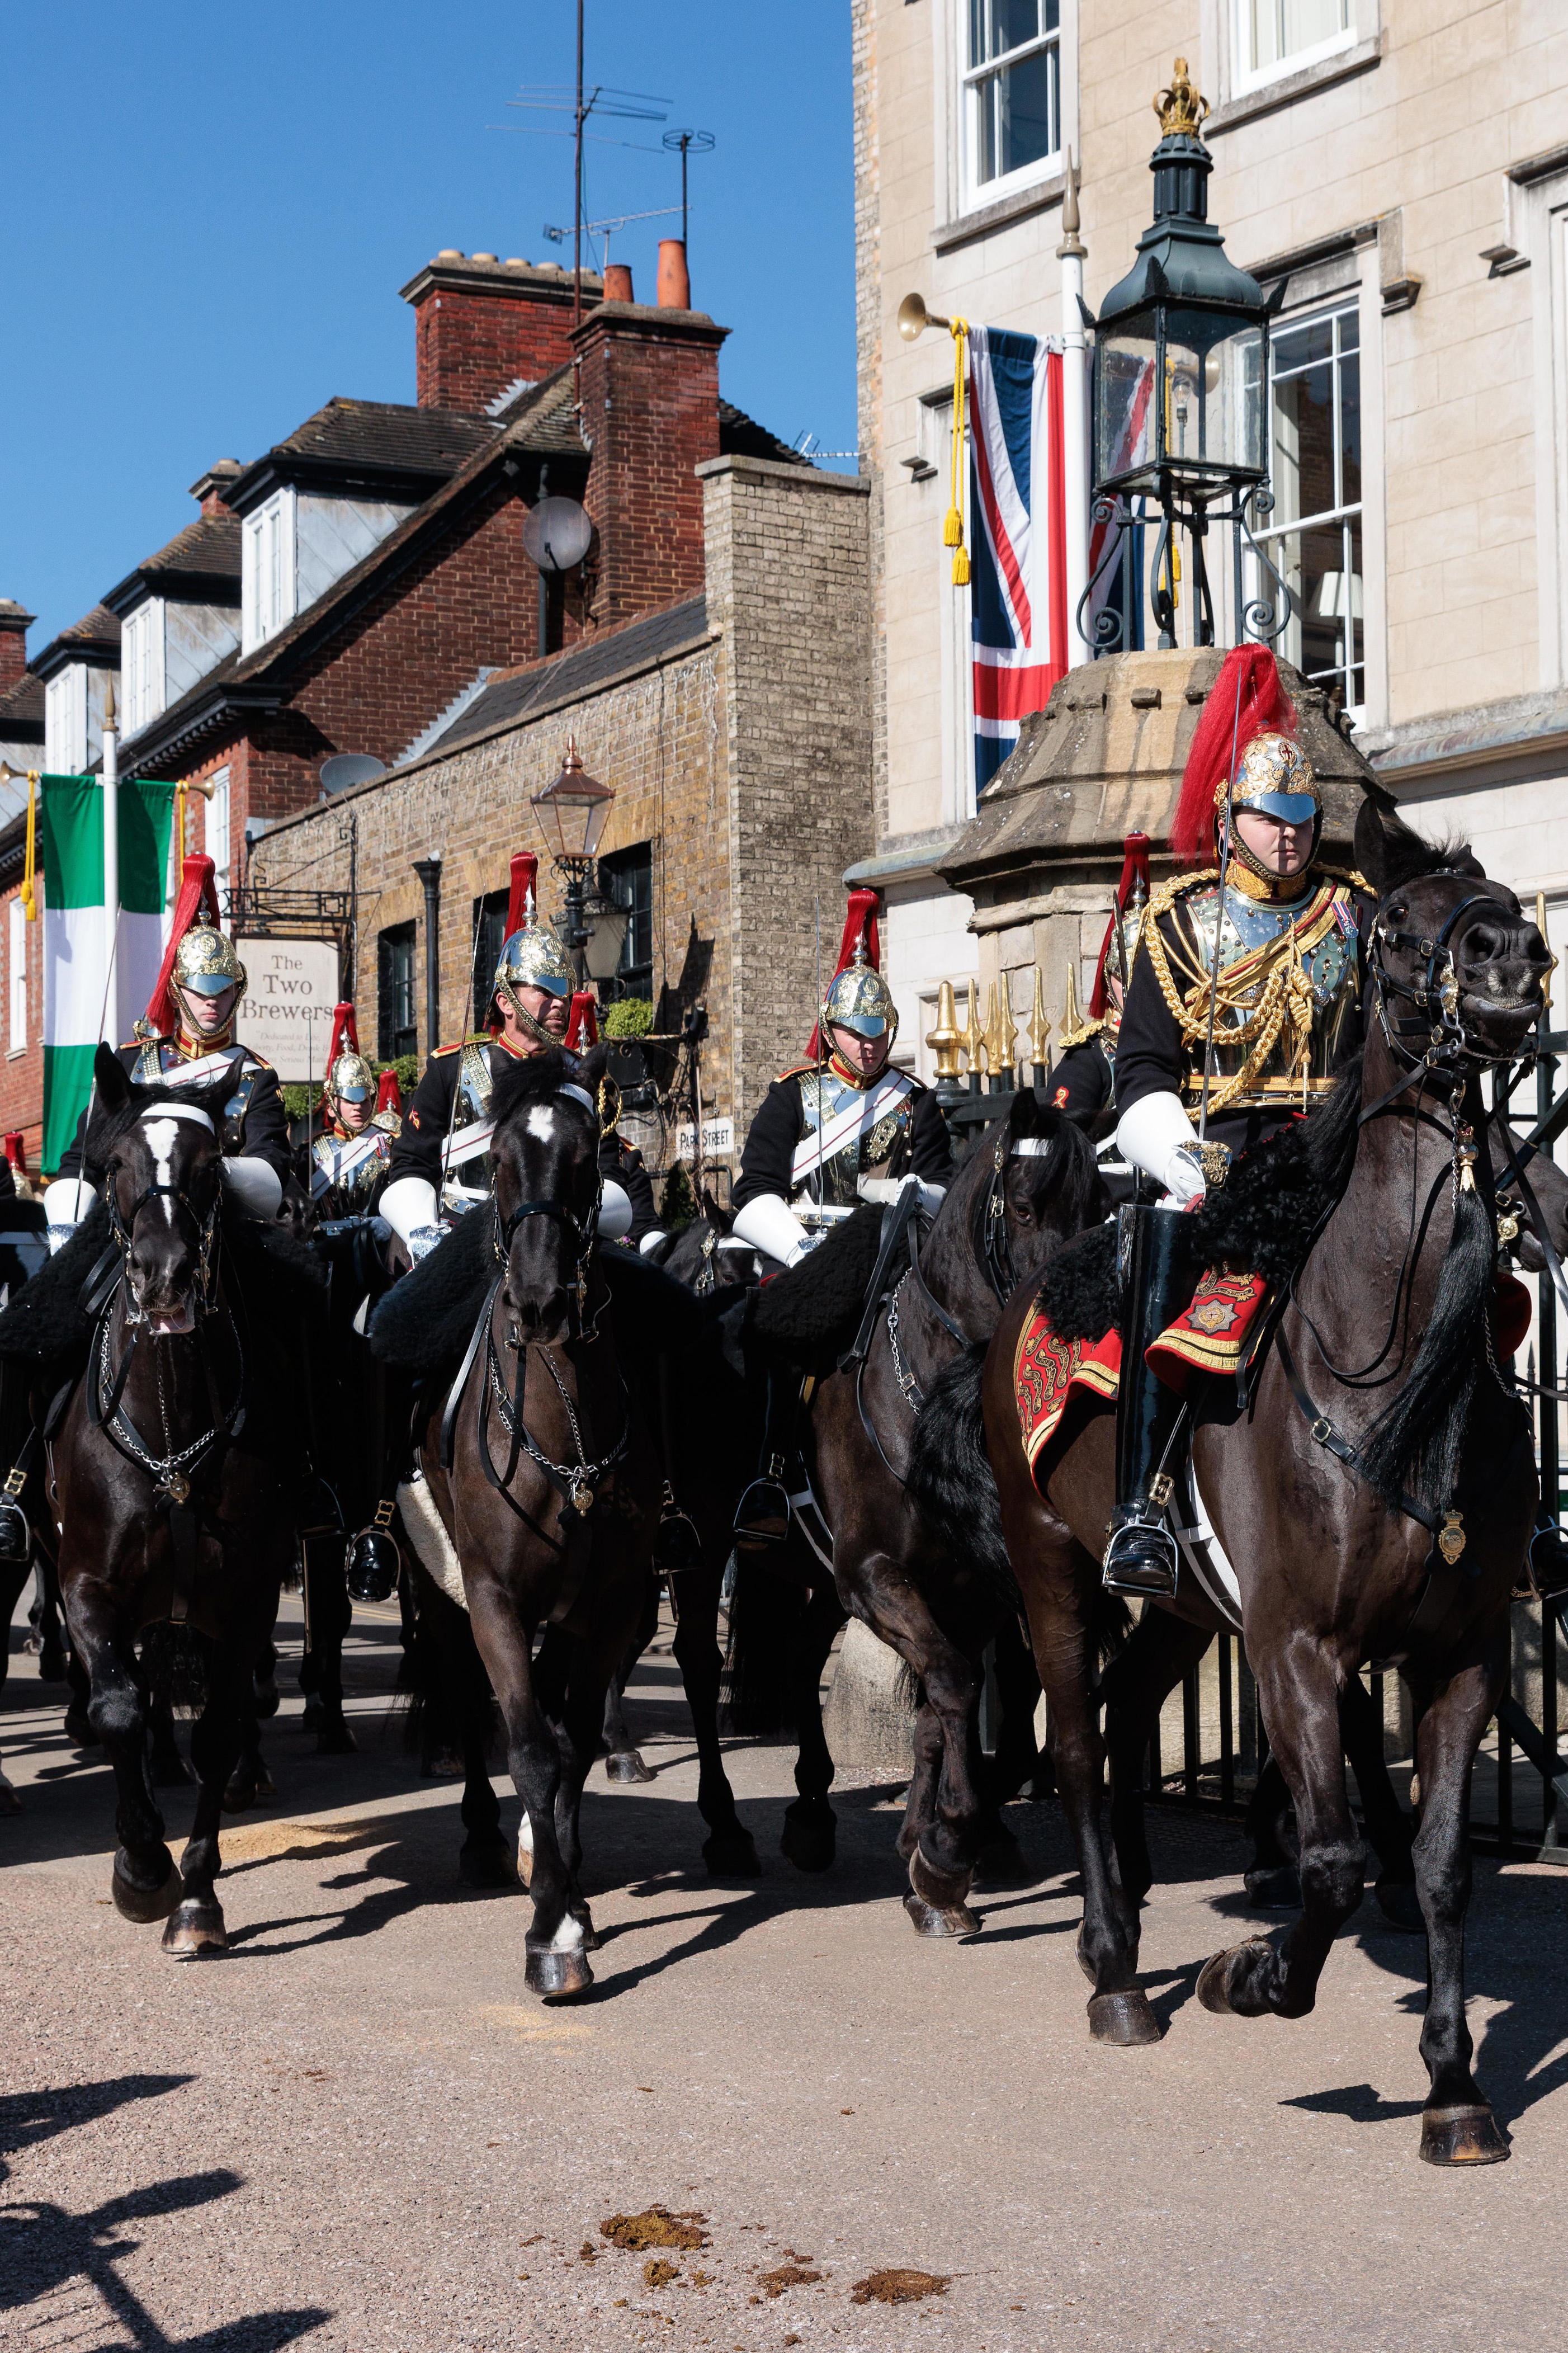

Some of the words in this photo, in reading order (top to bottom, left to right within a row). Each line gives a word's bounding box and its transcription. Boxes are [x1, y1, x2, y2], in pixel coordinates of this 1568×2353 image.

[272, 955, 303, 970] The
[263, 975, 313, 995] Two
[240, 999, 333, 1020] Brewers
[681, 1133, 699, 1148] PARK
[702, 1128, 729, 1147] STREET
